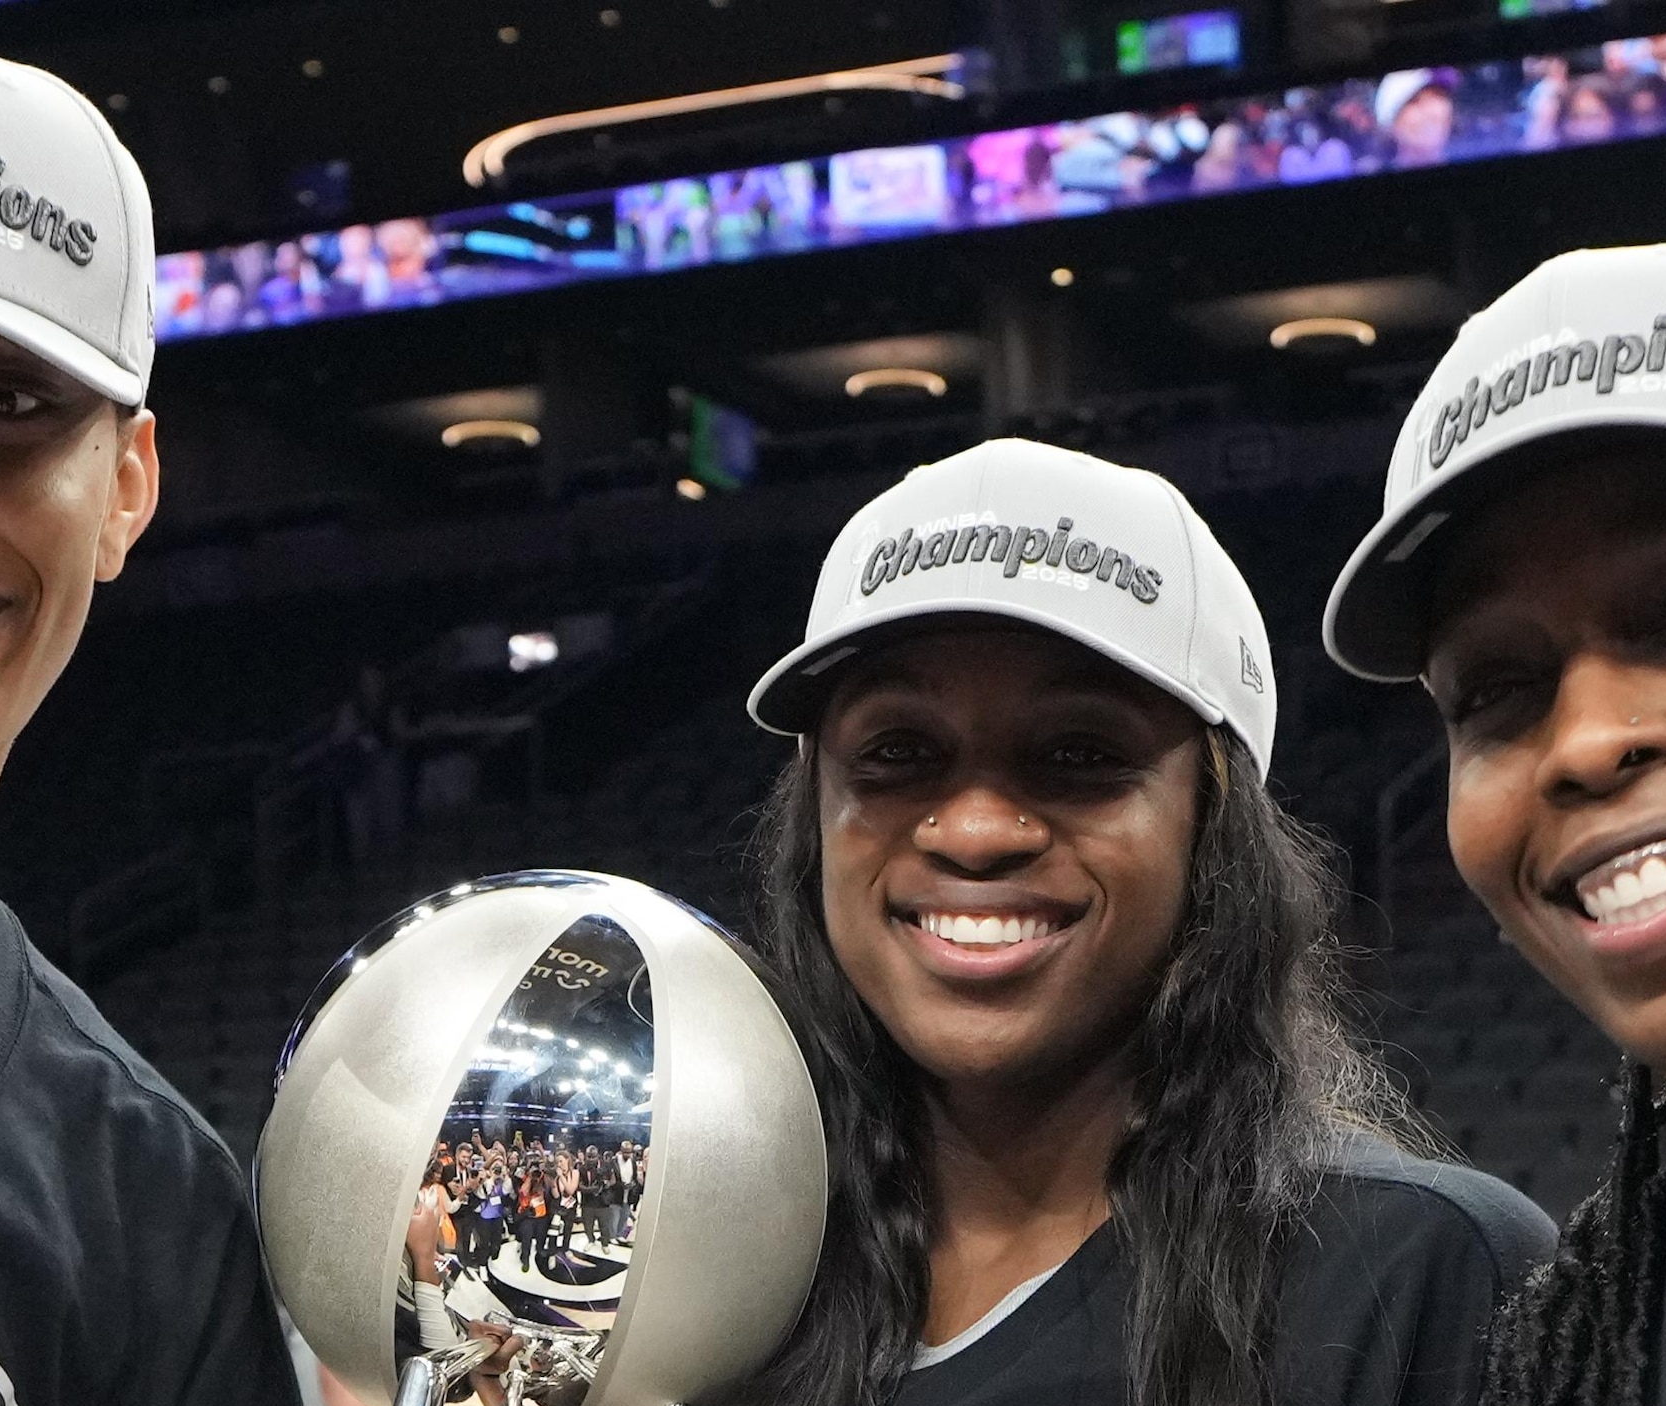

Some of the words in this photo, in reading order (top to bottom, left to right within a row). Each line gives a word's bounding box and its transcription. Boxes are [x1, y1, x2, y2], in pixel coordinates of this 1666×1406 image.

[915, 509, 999, 538] WNBA
[860, 516, 1163, 604] Champions
[1020, 562, 1091, 592] 2025
